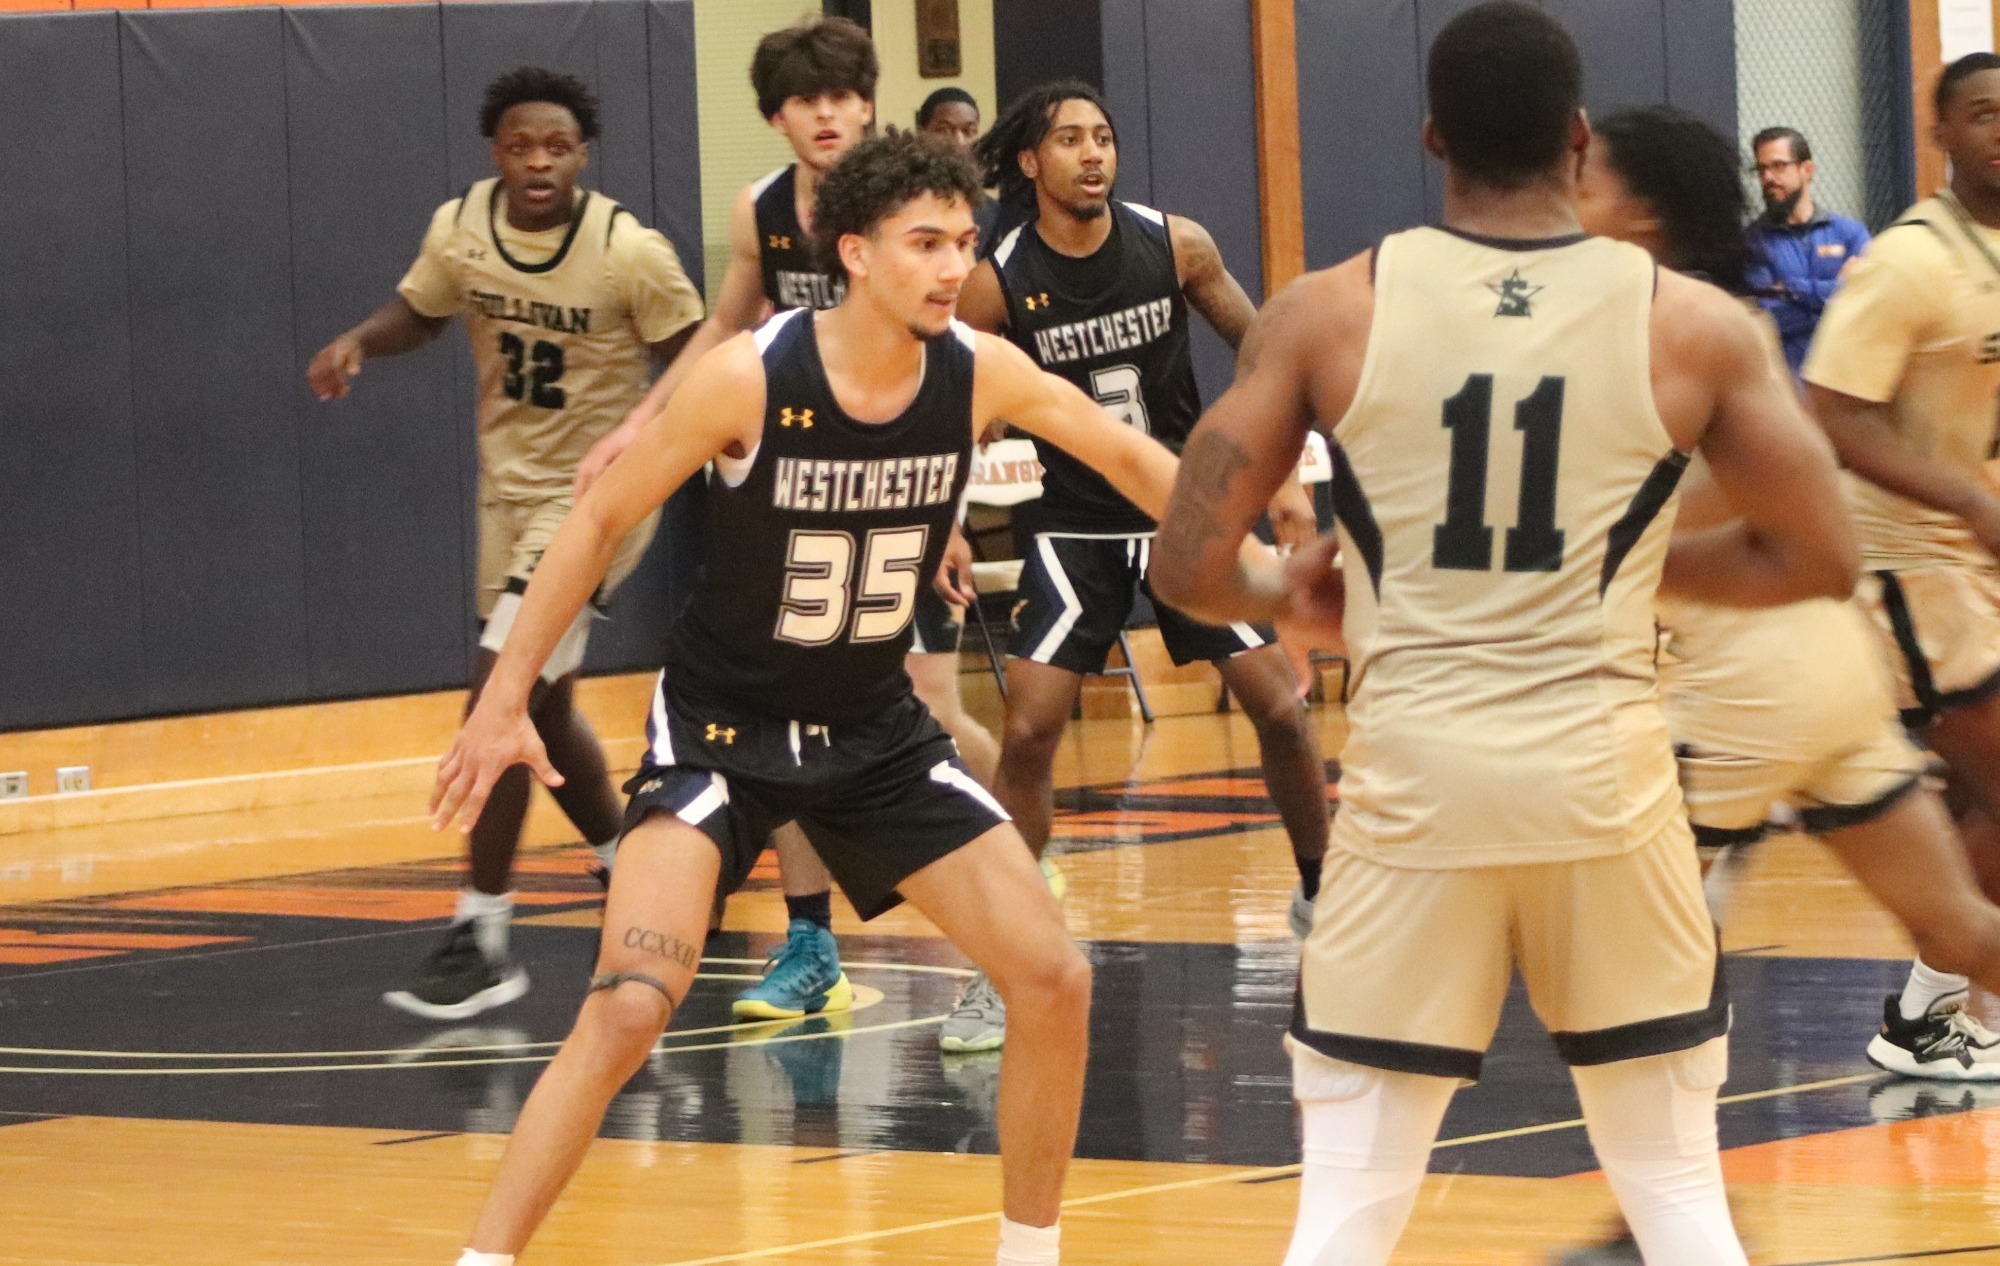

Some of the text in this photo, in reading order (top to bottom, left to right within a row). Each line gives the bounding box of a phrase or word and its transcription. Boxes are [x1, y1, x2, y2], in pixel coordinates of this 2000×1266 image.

[1033, 296, 1172, 365] WESTCHESTER
[498, 331, 566, 410] 32
[773, 452, 959, 512] WESTCHESTER
[1432, 373, 1565, 572] 11
[773, 524, 930, 646] 35
